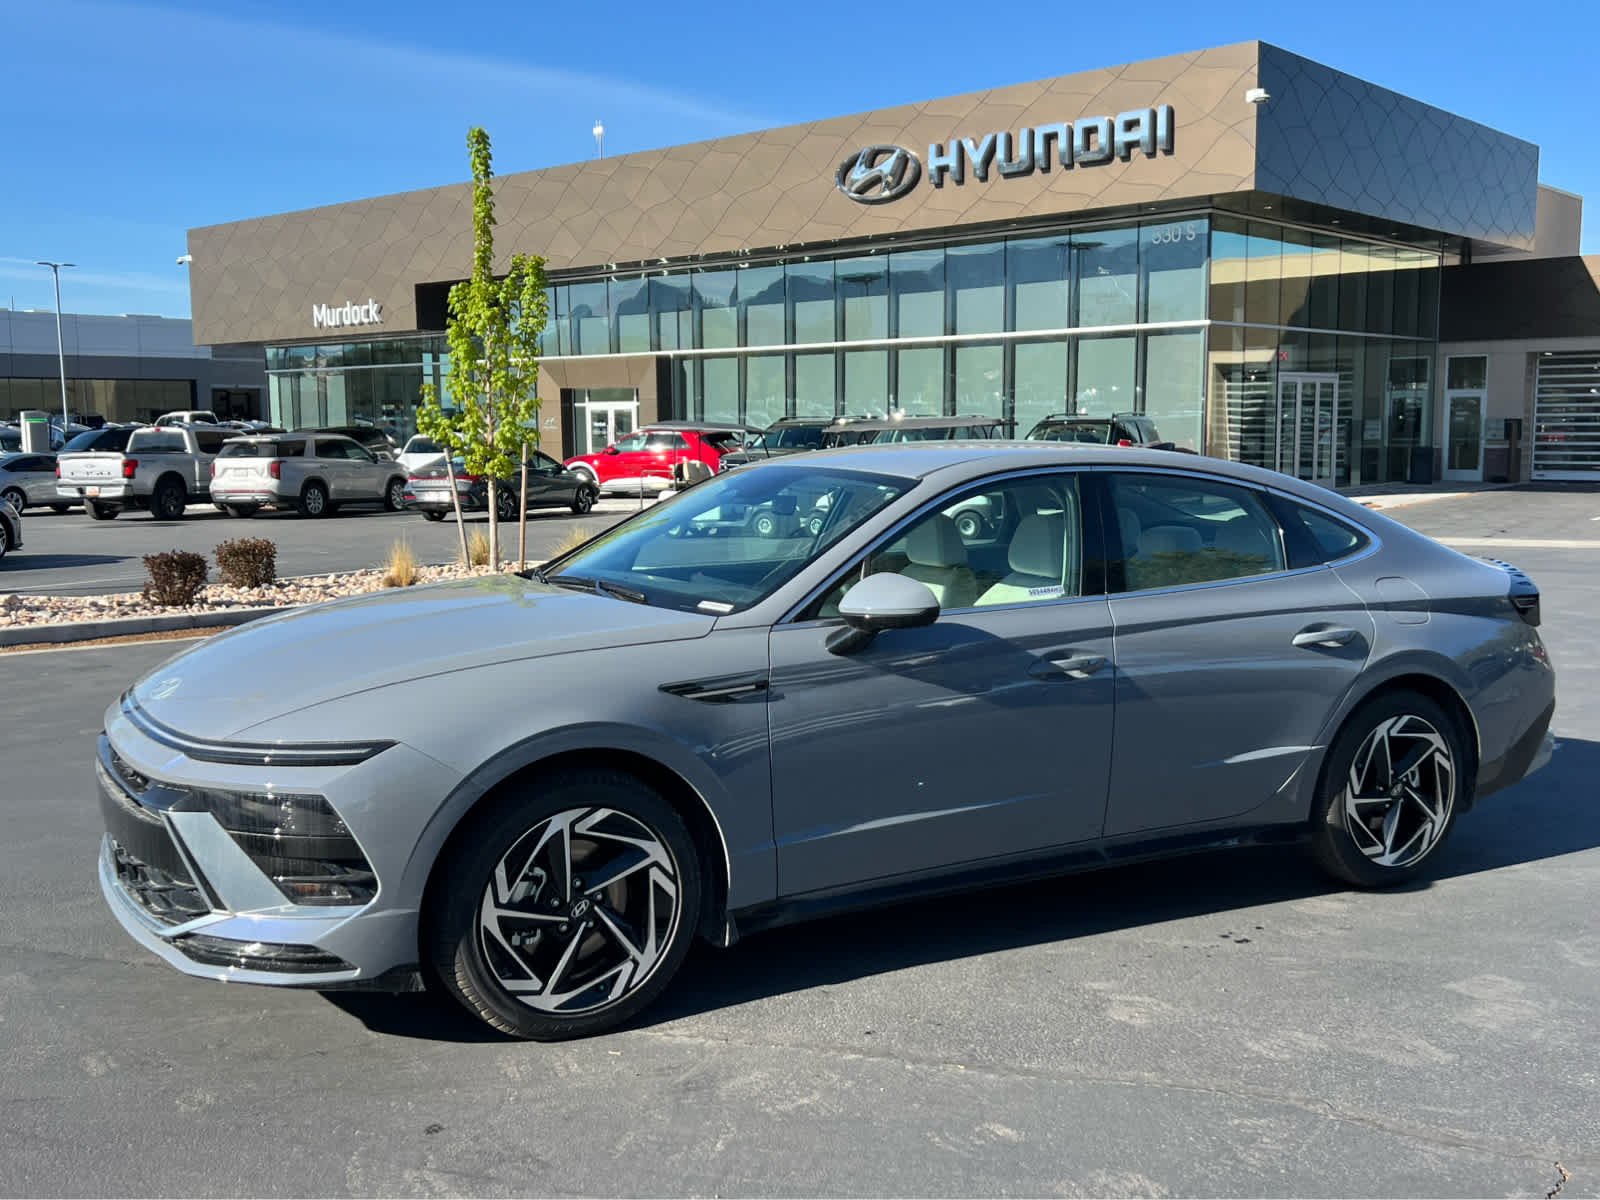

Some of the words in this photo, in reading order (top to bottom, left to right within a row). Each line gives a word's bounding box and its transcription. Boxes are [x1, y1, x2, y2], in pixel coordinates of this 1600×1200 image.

[928, 104, 1174, 188] HYUNDAI
[1185, 223, 1196, 241] S
[312, 298, 381, 328] Murdock
